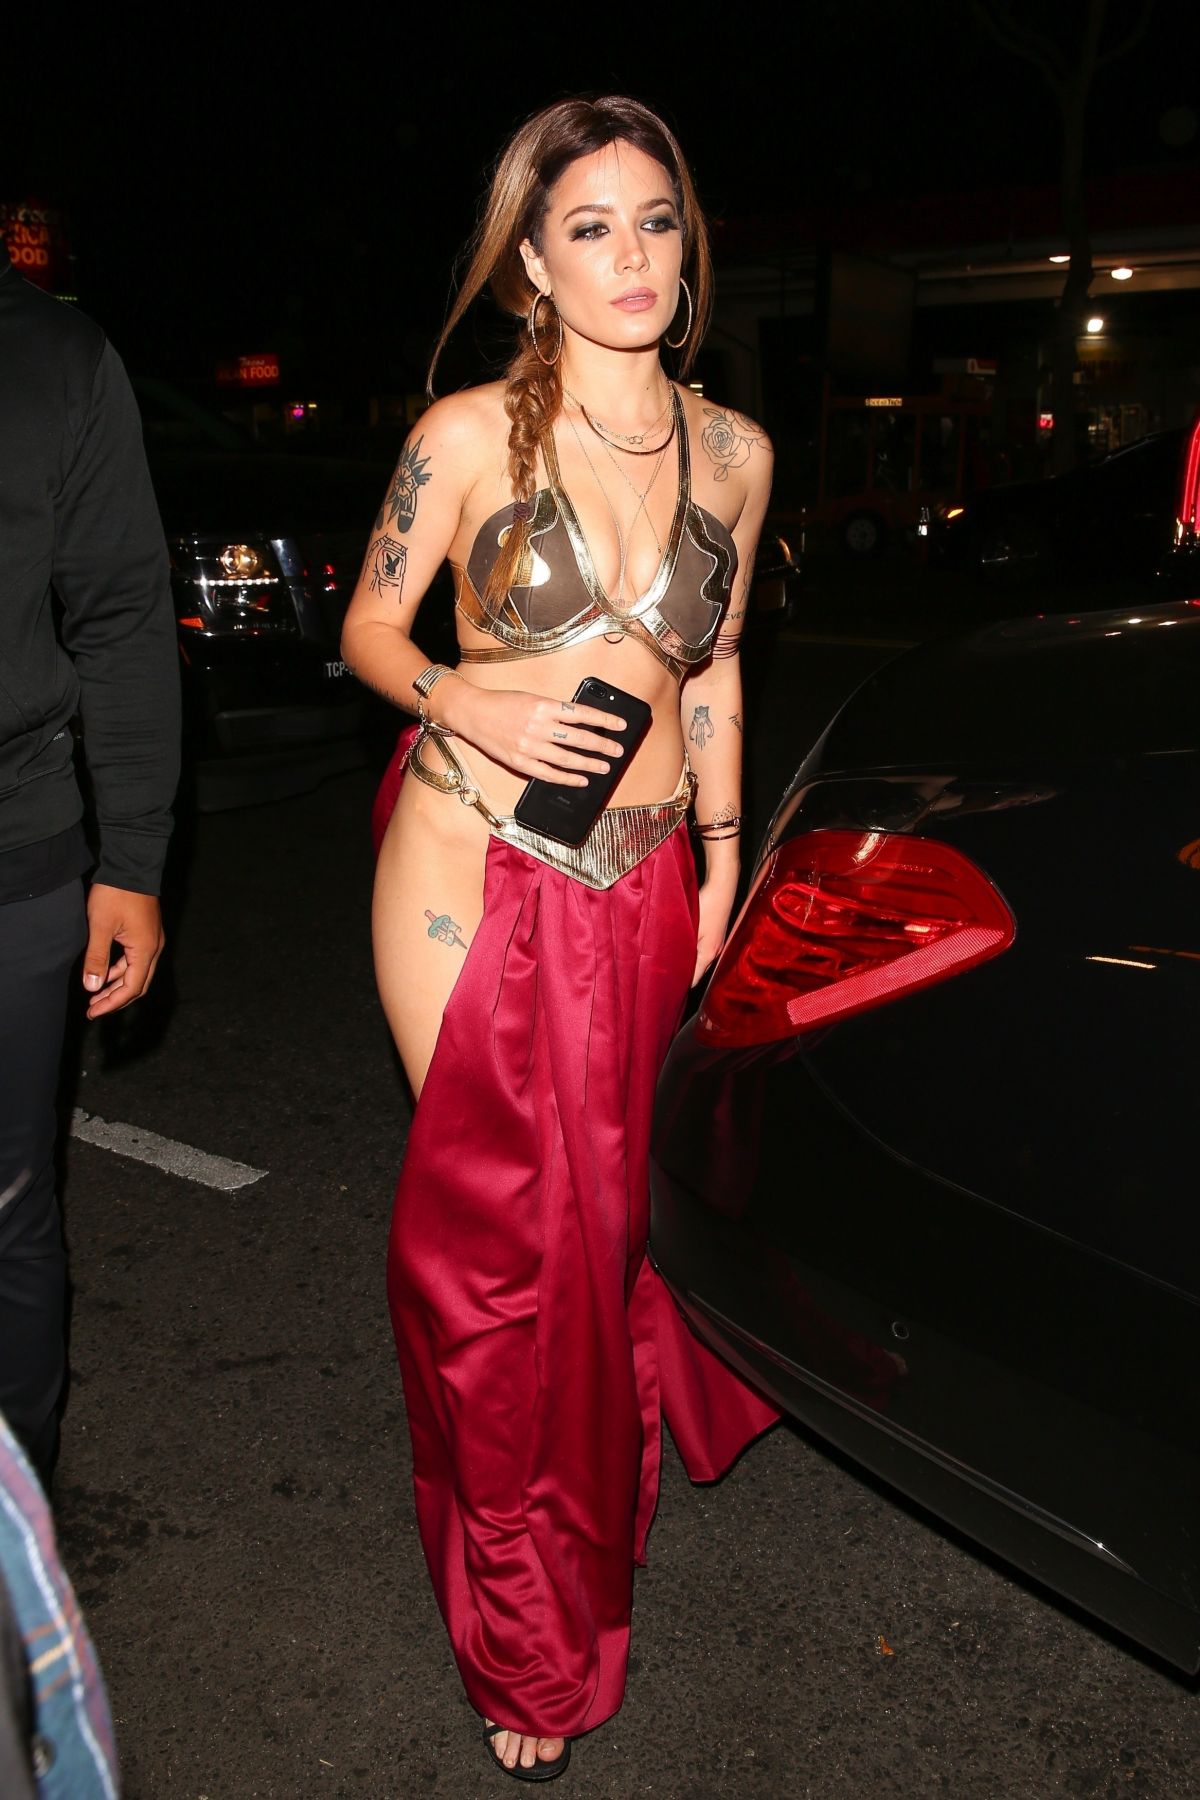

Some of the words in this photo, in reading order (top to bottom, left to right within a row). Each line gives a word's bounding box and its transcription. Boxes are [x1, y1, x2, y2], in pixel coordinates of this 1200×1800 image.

[8, 246, 49, 265] OOD
[250, 365, 279, 379] FOOD
[325, 661, 353, 679] TCP-
